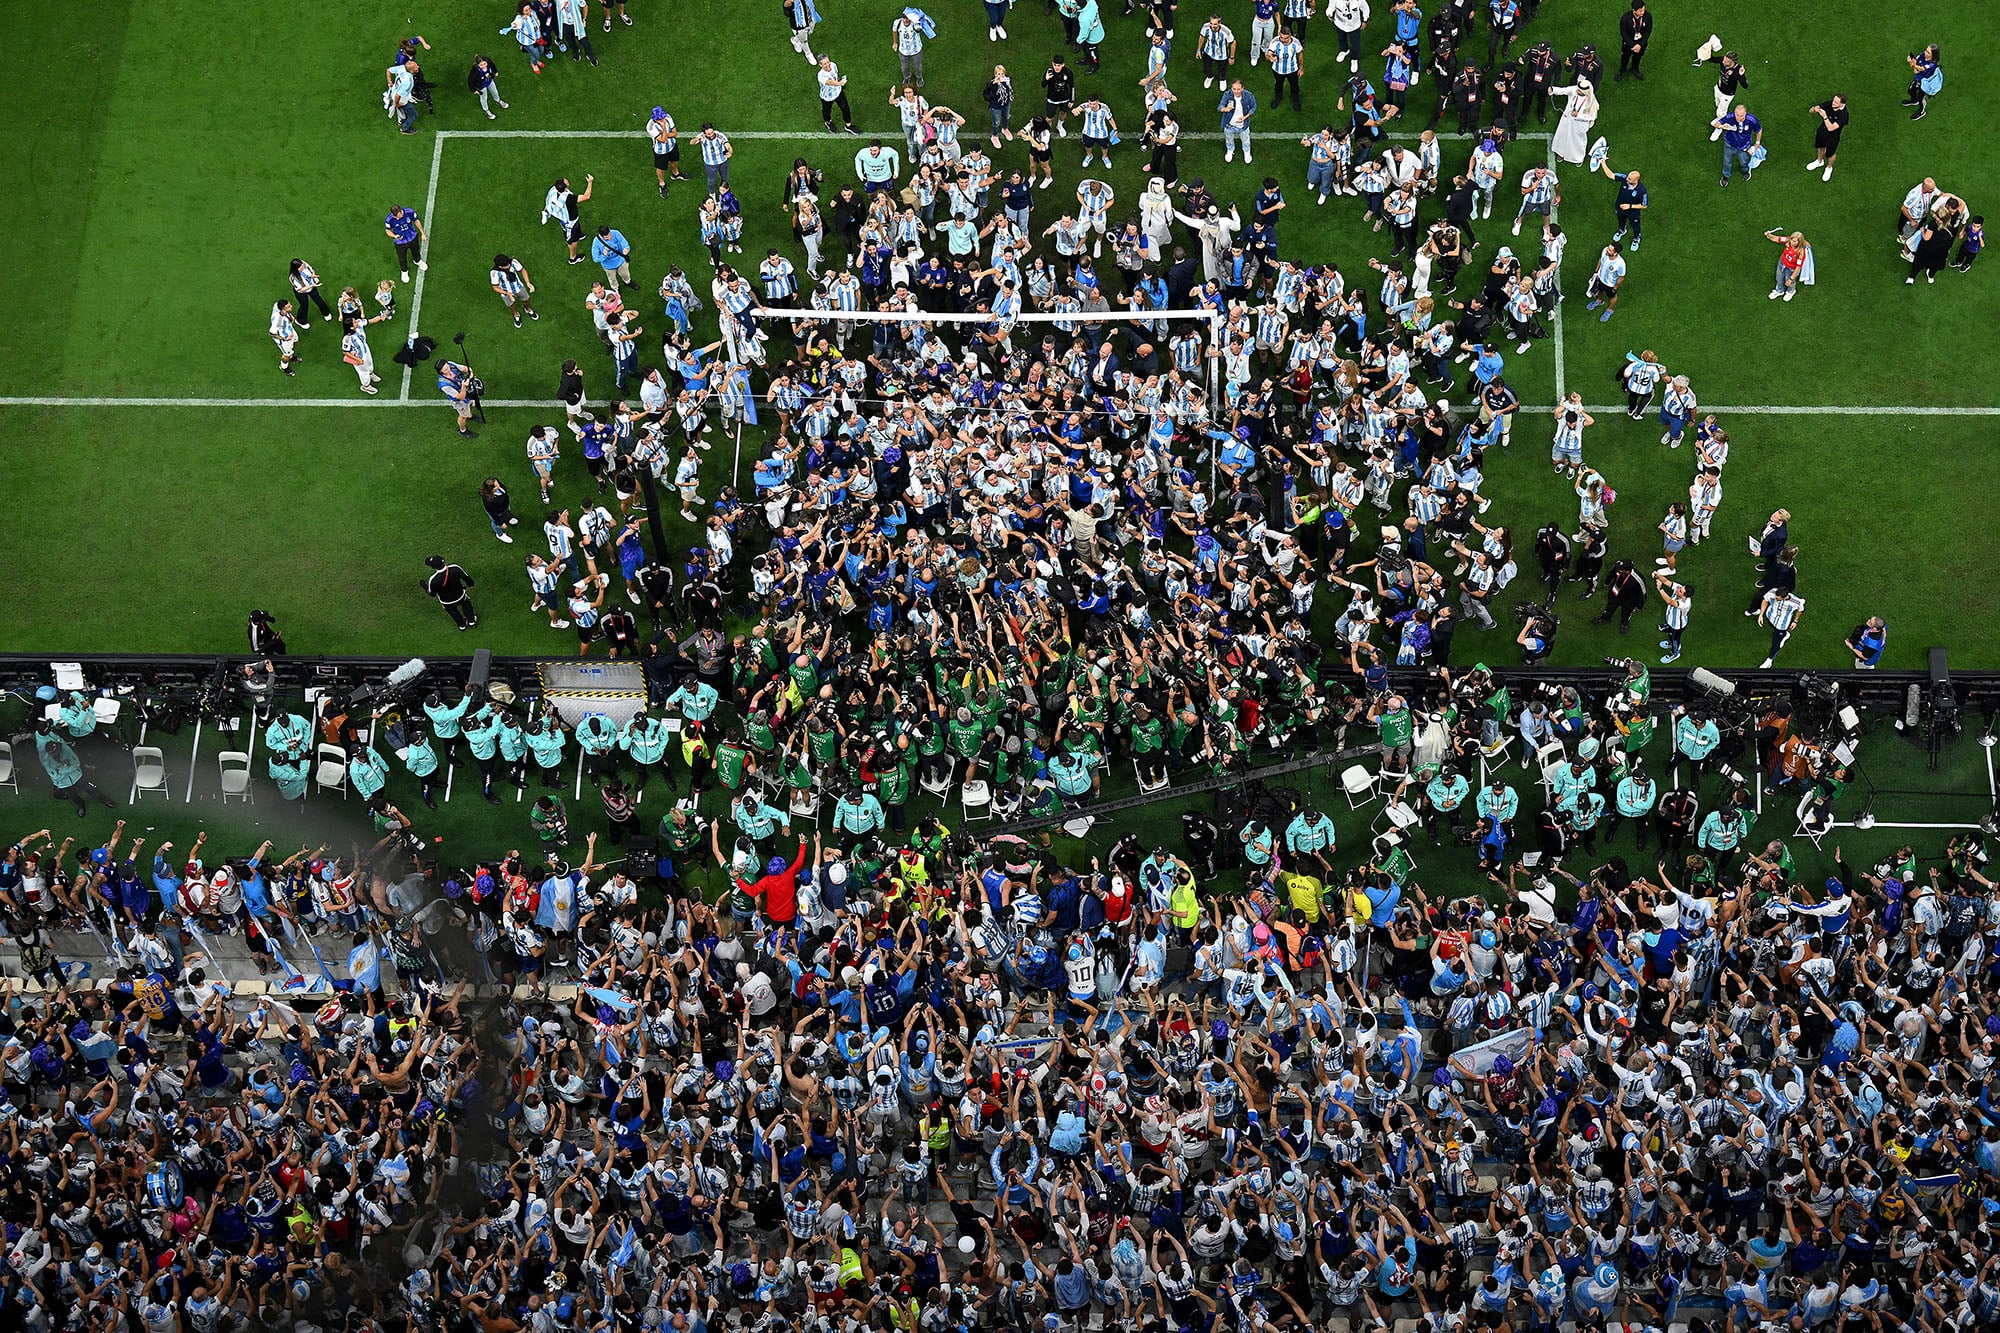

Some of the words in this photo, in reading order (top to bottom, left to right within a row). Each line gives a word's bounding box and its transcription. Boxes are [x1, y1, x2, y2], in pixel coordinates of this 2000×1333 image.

[550, 534, 558, 546] 9
[1390, 714, 1409, 725] PHOTO
[1073, 740, 1091, 751] PHOTO
[719, 748, 737, 757] PHOTO
[1384, 856, 1399, 872] PHOTO
[1681, 904, 1701, 918] 10
[1072, 966, 1090, 983] 10
[874, 995, 895, 1013] 10
